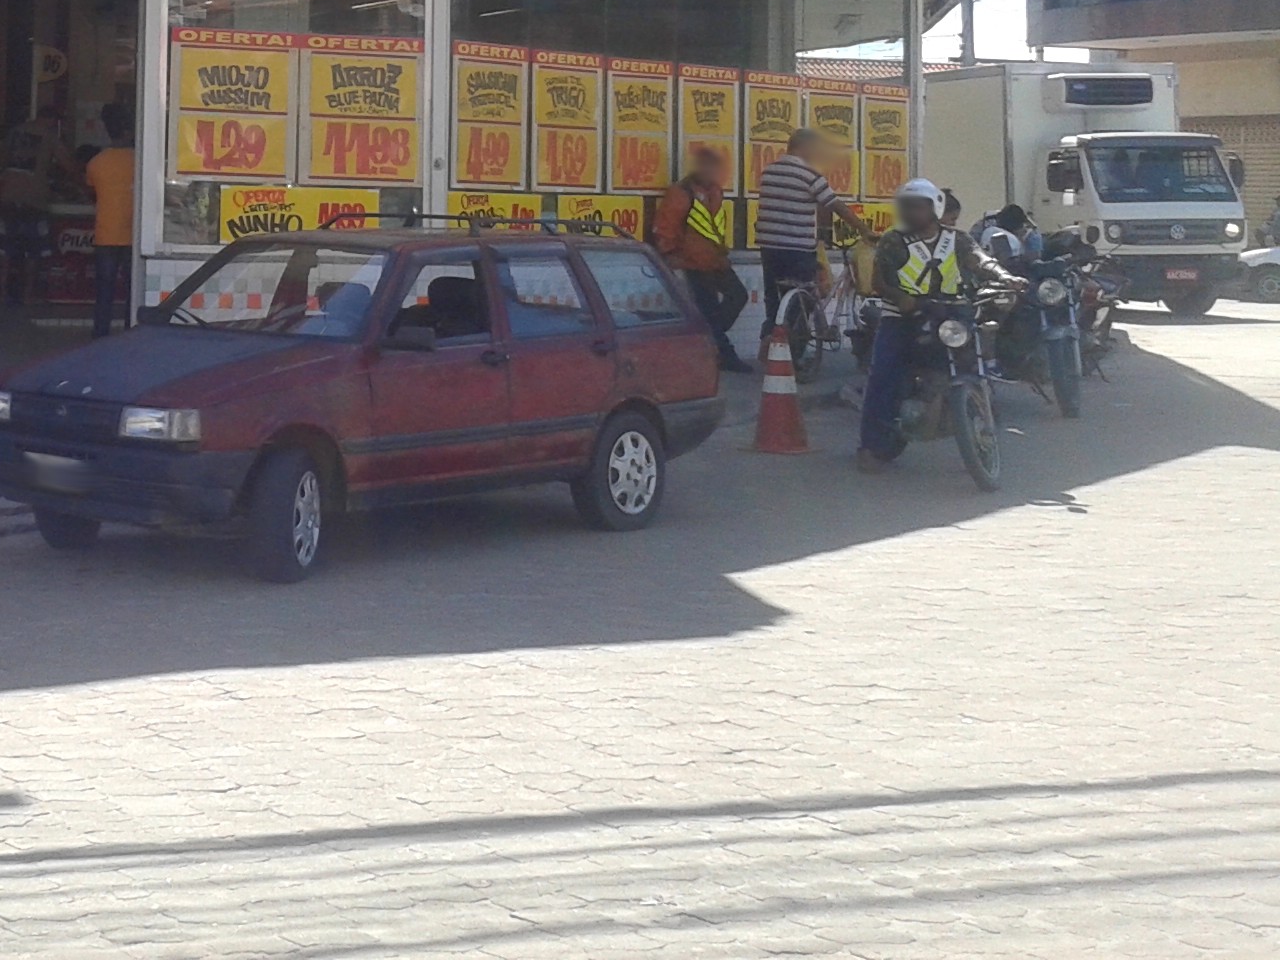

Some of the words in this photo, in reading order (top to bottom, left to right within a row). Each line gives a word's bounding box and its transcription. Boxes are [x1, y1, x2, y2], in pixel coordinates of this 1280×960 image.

[179, 29, 293, 47] OFERTA!
[307, 36, 420, 53] OFERTA!
[458, 43, 525, 60] OFERTA!
[536, 51, 600, 68] OFERTA!
[611, 59, 670, 75] OFERTA!
[682, 66, 737, 81] OFERTA!
[198, 65, 269, 89] MIOJO
[331, 63, 402, 95] ARROZ
[748, 73, 799, 86] OFERTA!
[809, 79, 857, 92] OFERTA!
[863, 85, 908, 97] OFERTA!
[226, 213, 303, 240] NINHO
